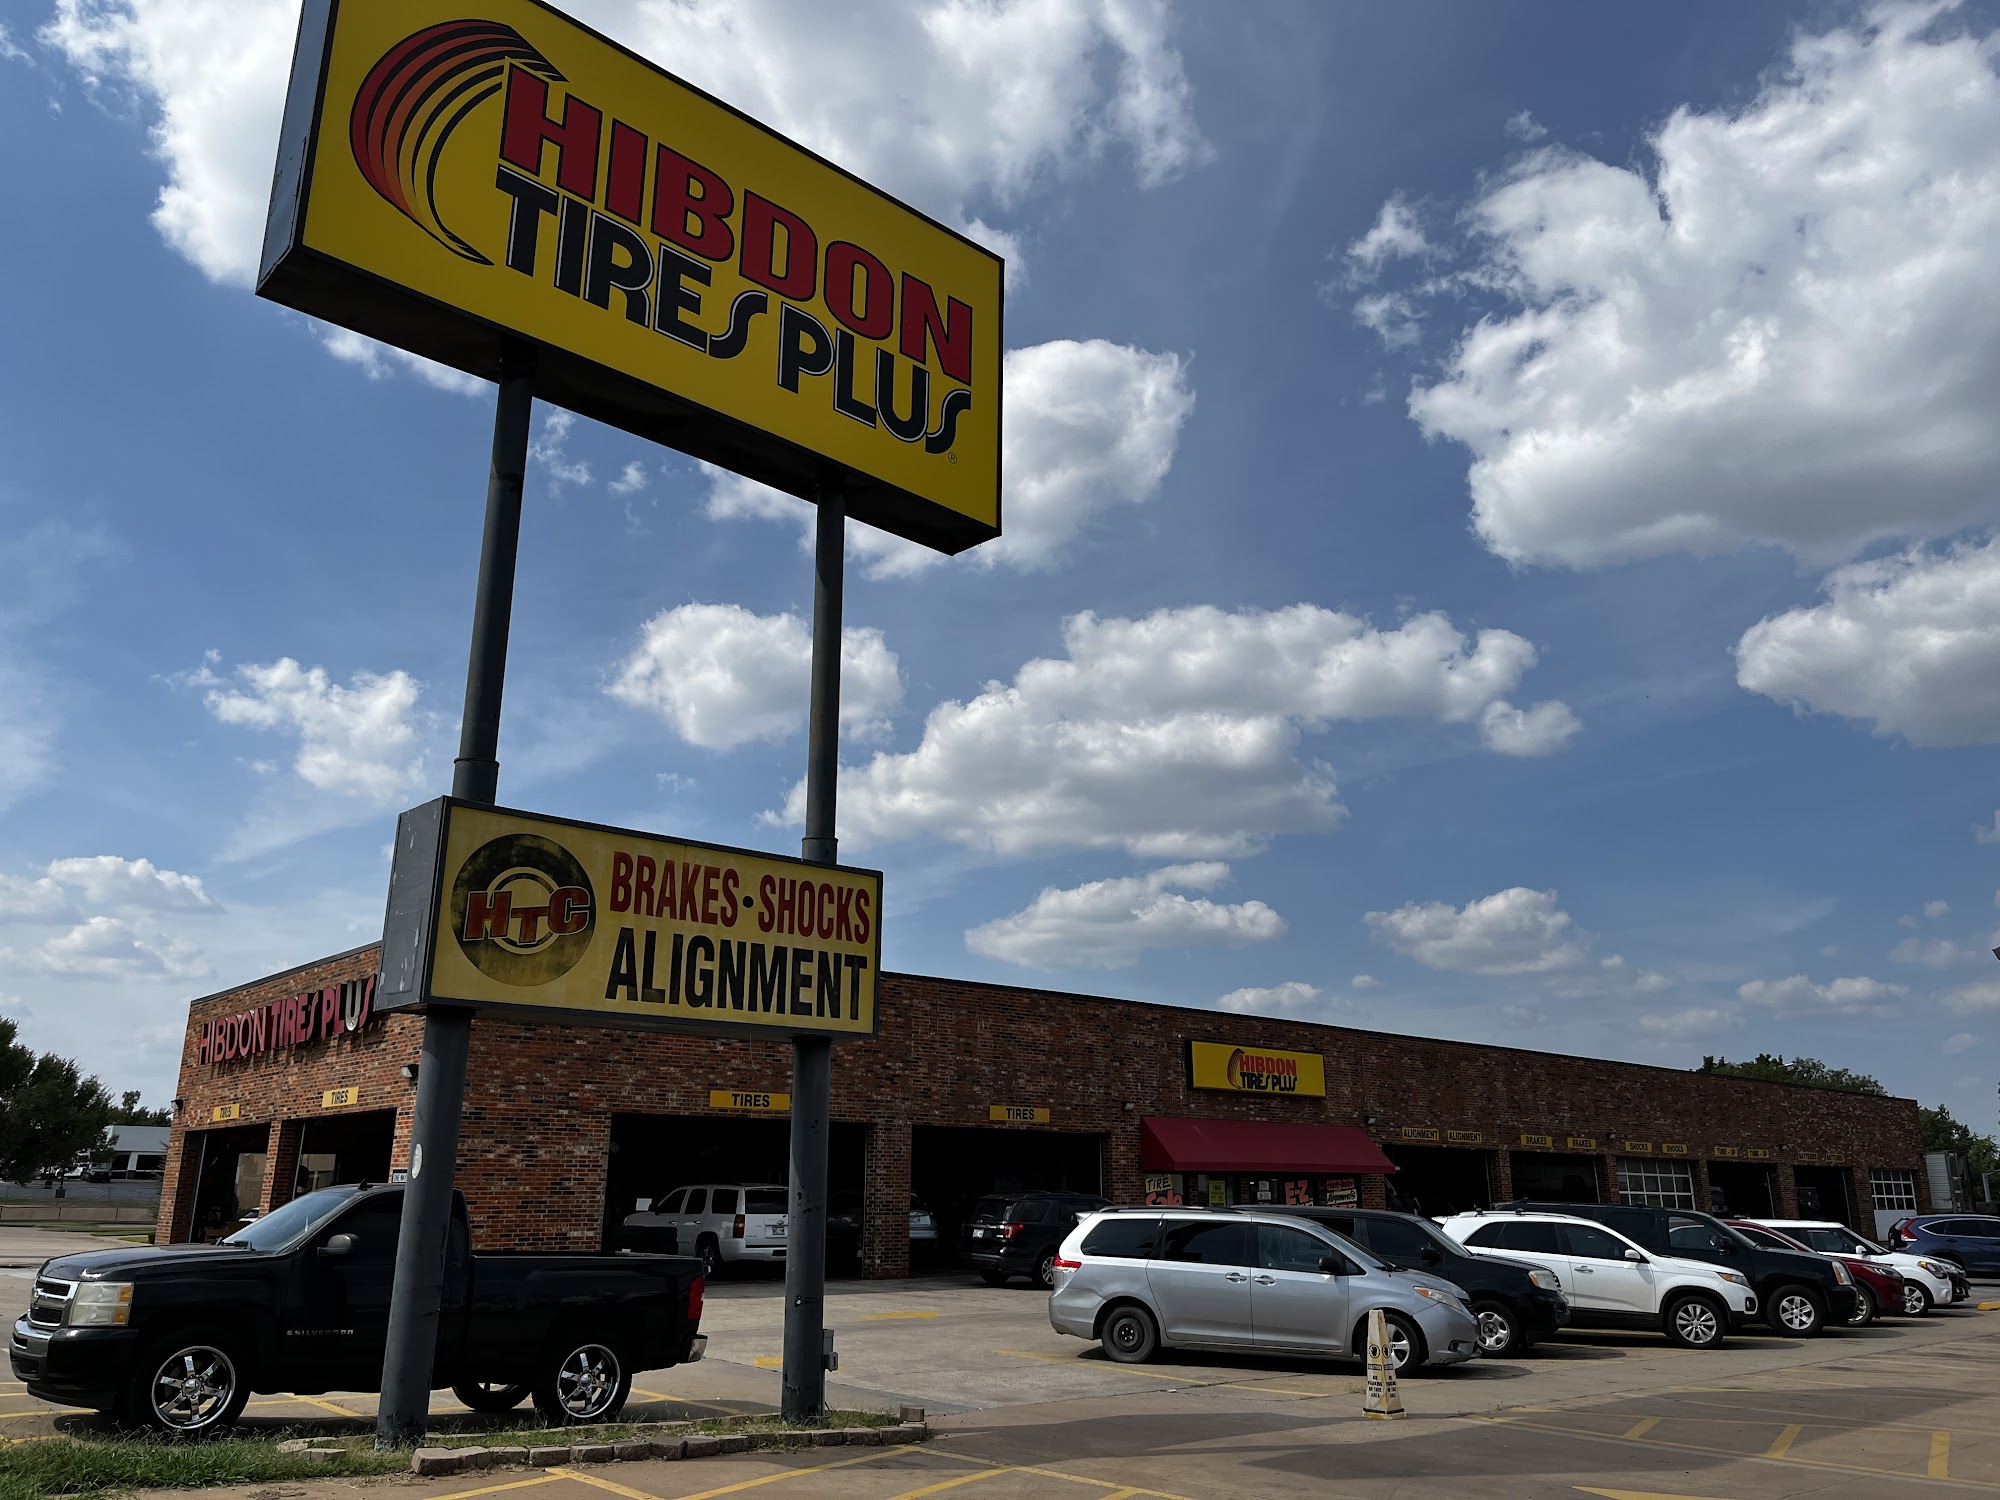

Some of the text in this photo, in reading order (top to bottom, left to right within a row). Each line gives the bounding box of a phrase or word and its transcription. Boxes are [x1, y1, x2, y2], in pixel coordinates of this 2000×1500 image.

[499, 58, 973, 387] HIBDON
[496, 163, 972, 454] TIRES PLUS
[609, 850, 871, 945] BRAKES SHOCKS
[463, 884, 591, 945] HTC
[604, 926, 868, 1022] ALIGNMENT
[199, 973, 377, 1065] HIBDON TIRES PLUS
[1239, 1054, 1297, 1076] HIBDON
[1240, 1072, 1297, 1092] TIRES PLUS
[331, 1089, 349, 1105] TIRES
[731, 1093, 771, 1108] TIRES
[219, 1107, 232, 1118] TIRES
[1005, 1108, 1036, 1120] TIRES
[1403, 1128, 1438, 1140] ALIGNMENT
[1448, 1131, 1482, 1142] ALIGNMENT
[1526, 1135, 1548, 1146] BRAKES
[1572, 1138, 1592, 1148] BRAKES
[1629, 1143, 1648, 1151] SHOCKS
[1666, 1145, 1684, 1153] SHOCKS
[1147, 1176, 1171, 1191] TIRE
[1285, 1179, 1310, 1206] E-Z
